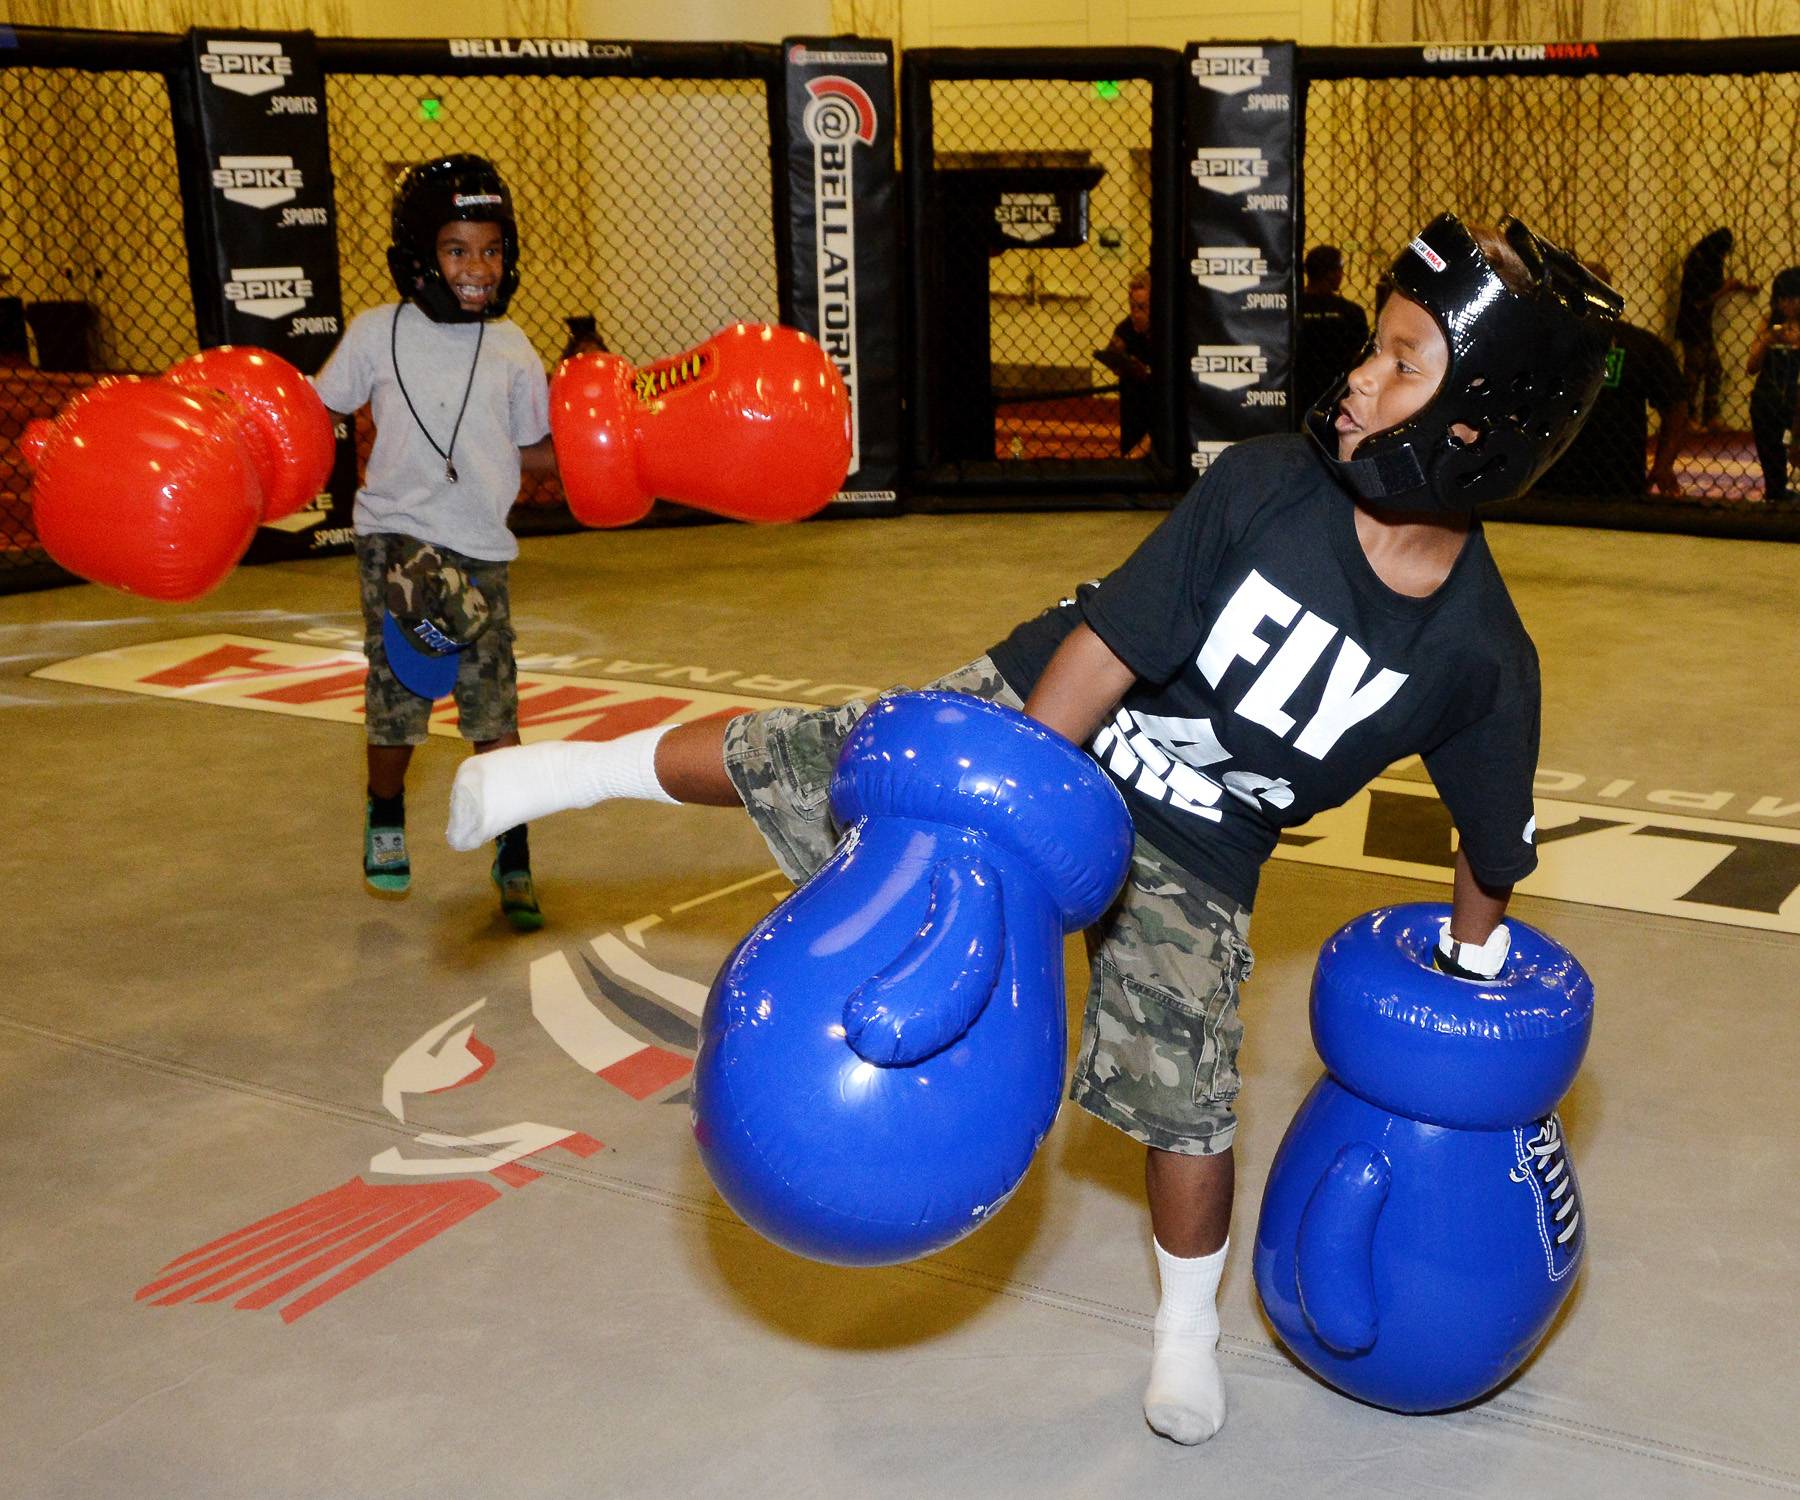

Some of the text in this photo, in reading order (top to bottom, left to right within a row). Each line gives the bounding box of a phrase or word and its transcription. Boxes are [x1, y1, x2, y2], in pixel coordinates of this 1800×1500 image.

[1423, 43, 1599, 62] @BELLATORMMA
[200, 54, 292, 75] SPIKE
[1191, 58, 1270, 76] SPIKE
[1191, 160, 1269, 177] SPIKE
[212, 169, 303, 188] SPIKE
[994, 205, 1061, 222] SPIKE
[1190, 259, 1268, 276] SPIKE
[224, 279, 314, 300] SPIKE
[1190, 357, 1268, 373] SPIKE
[1196, 568, 1410, 761] FLY
